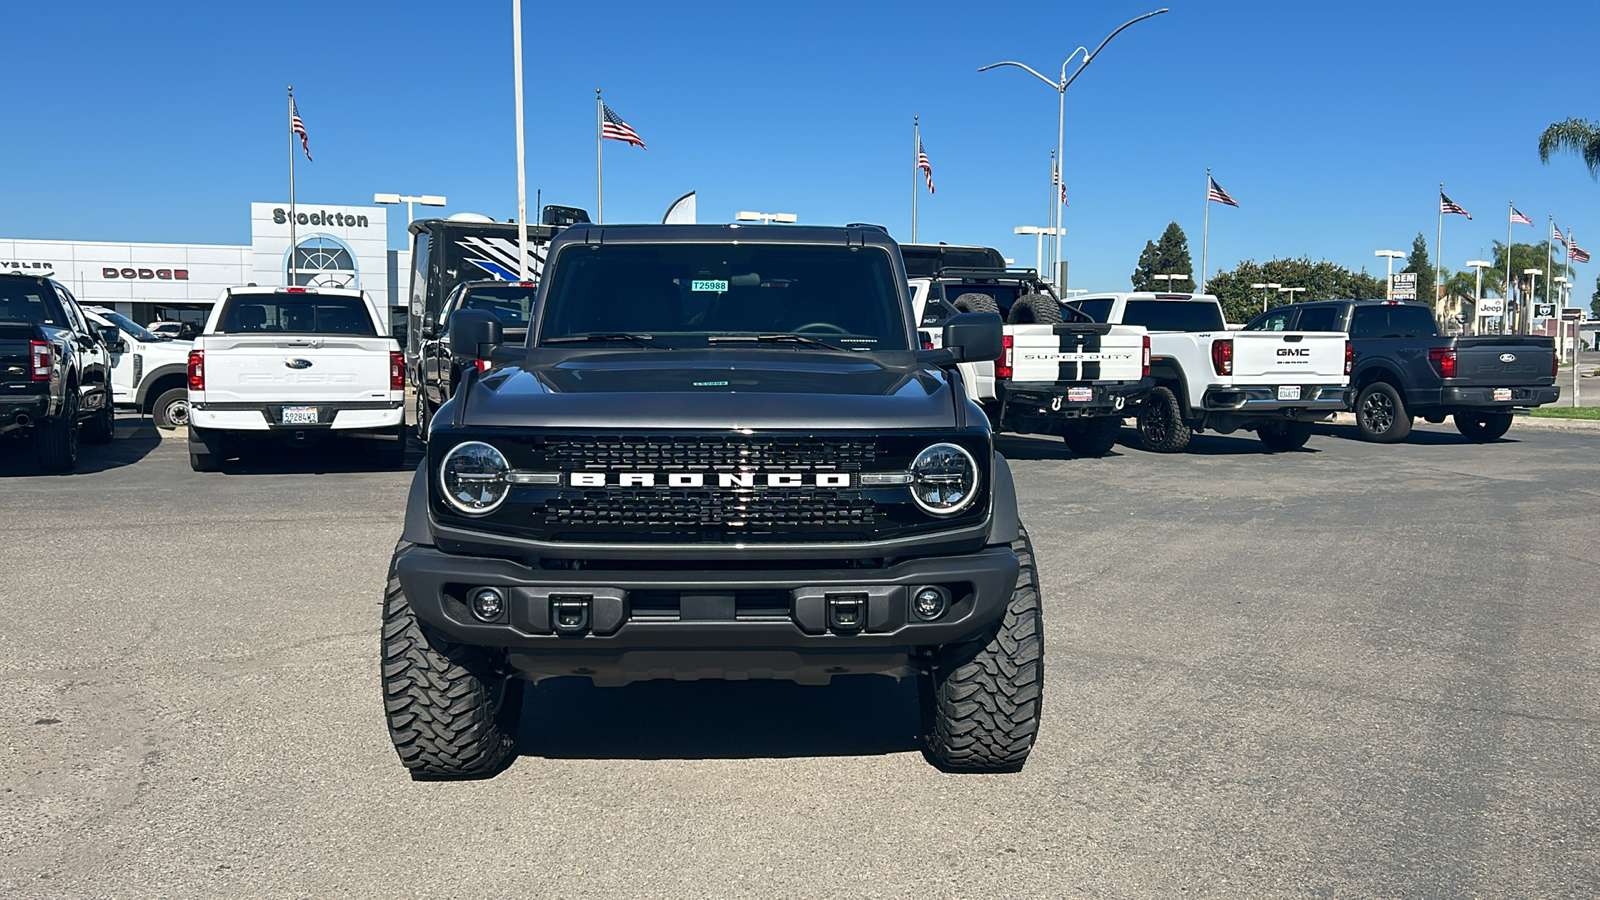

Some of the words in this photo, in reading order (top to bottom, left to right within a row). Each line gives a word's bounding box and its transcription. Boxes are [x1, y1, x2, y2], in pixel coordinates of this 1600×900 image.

[273, 208, 368, 227] Stockton
[102, 267, 189, 280] DODGE
[693, 282, 726, 290] T25988
[1480, 305, 1502, 313] Jeep
[1276, 348, 1310, 356] GMC
[239, 373, 358, 385] F-150
[570, 472, 851, 488] BRONCO
